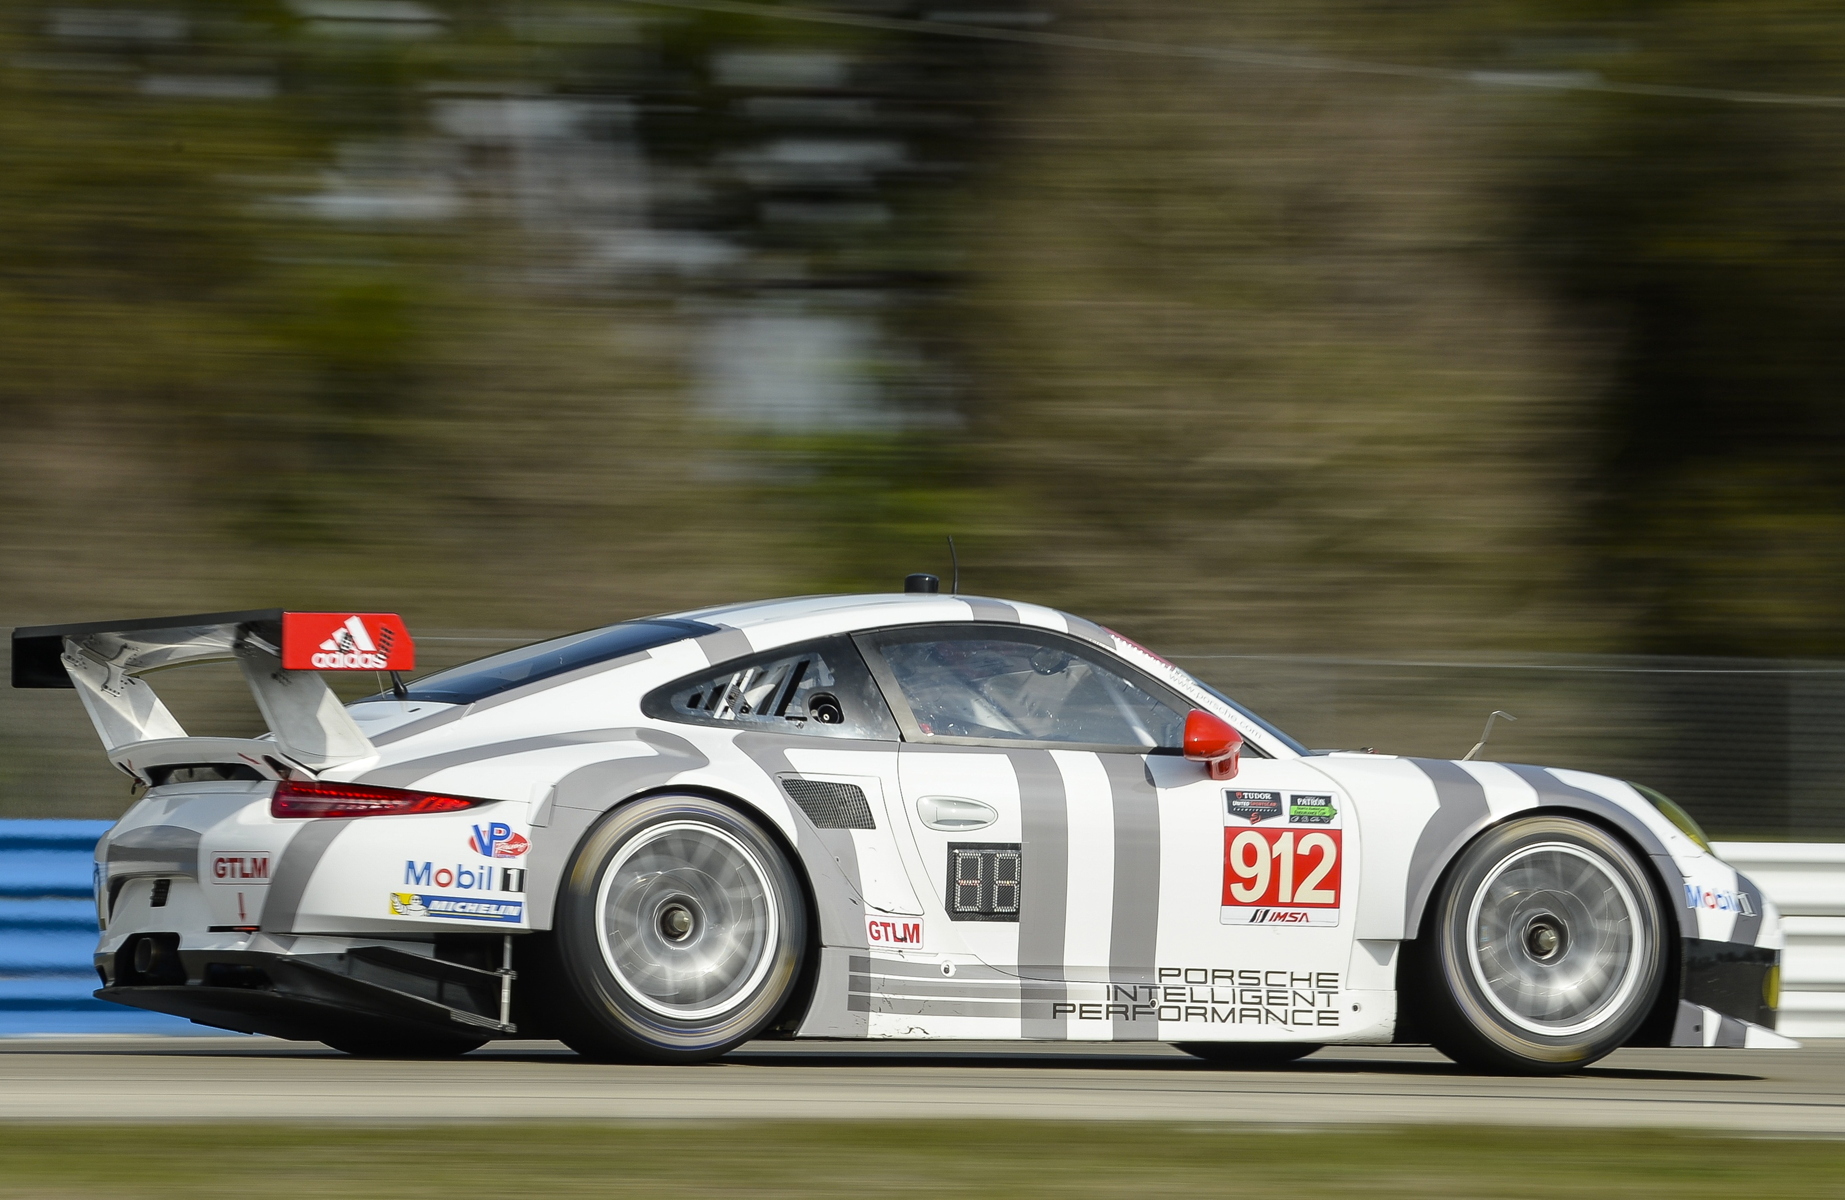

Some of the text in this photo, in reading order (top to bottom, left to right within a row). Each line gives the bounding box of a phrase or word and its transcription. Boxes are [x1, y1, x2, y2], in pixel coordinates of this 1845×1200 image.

[311, 652, 388, 668] adidas
[1243, 792, 1272, 800] TUDOR
[472, 822, 511, 857] VP
[213, 857, 269, 879] GTLM
[404, 860, 492, 891] Mobil
[1230, 830, 1337, 904] 912
[428, 900, 522, 916] MICHELIN
[1684, 883, 1738, 913] Mobil
[1269, 911, 1310, 923] IMSA
[868, 920, 921, 944] GTLM
[1158, 967, 1340, 990] PORSCHE
[1105, 984, 1340, 1008] INTELLIGENT
[1051, 1002, 1340, 1027] PERFORMANCE
